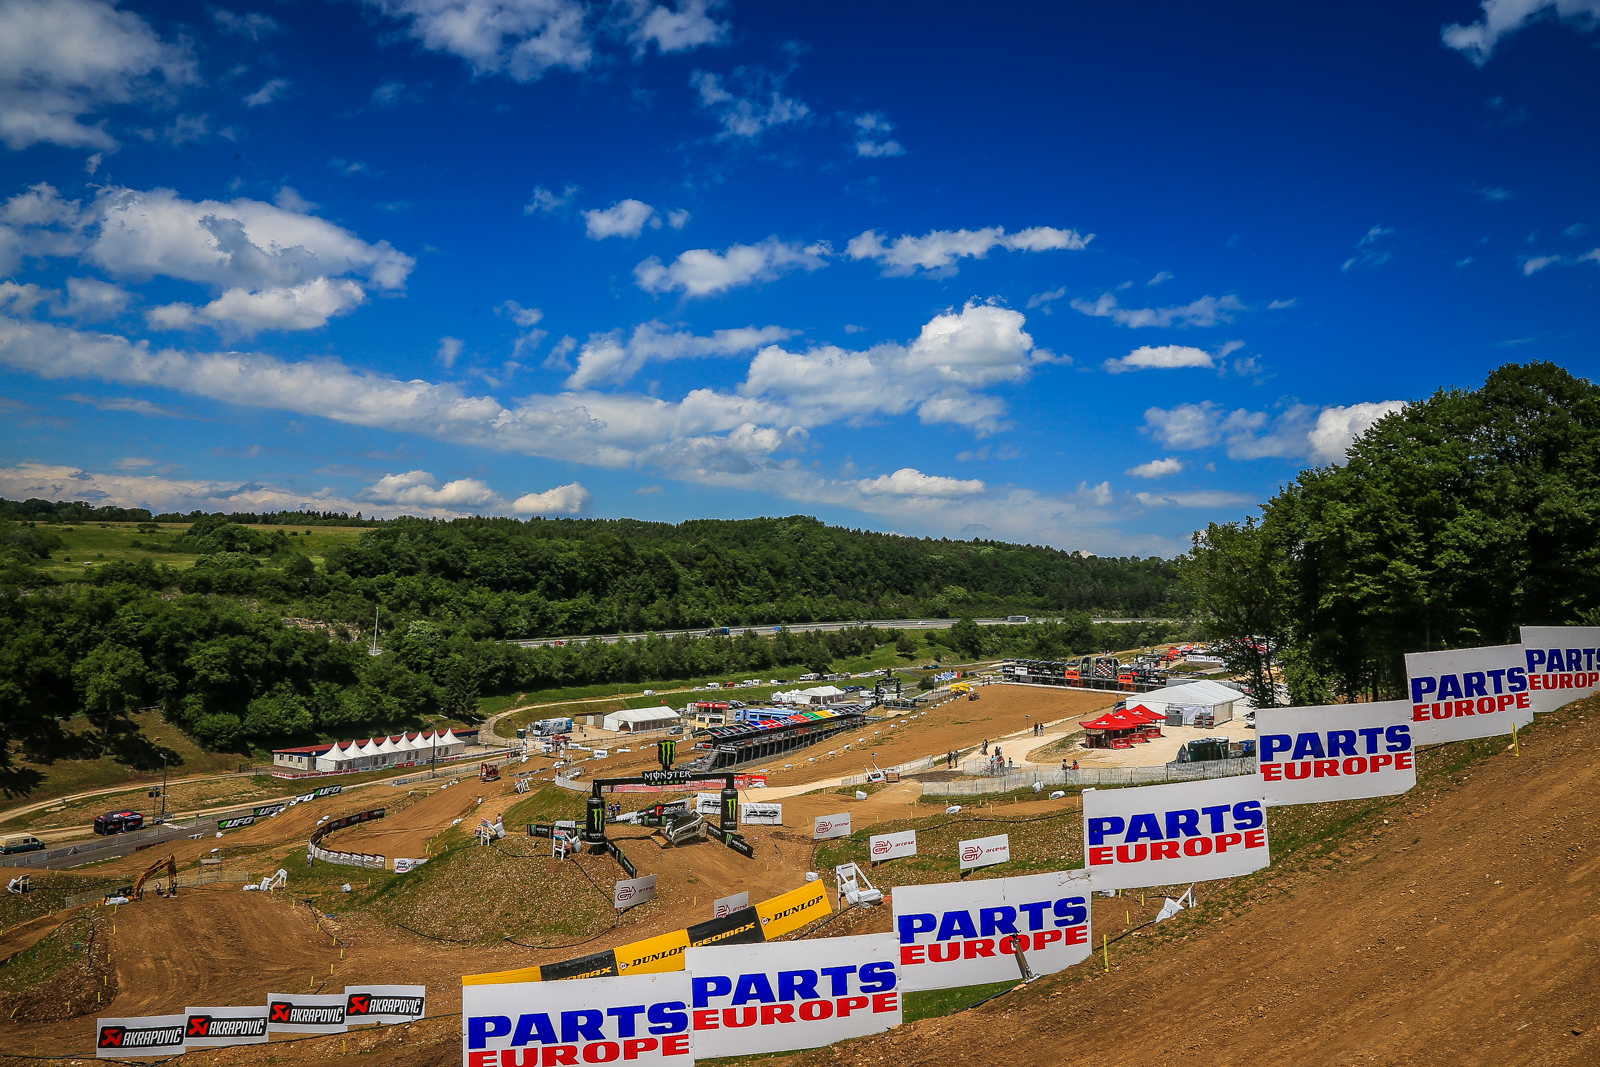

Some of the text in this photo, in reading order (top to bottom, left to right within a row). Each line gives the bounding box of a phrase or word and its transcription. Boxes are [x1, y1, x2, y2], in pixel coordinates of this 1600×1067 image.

[1525, 647, 1600, 673] PART
[1411, 667, 1528, 704] PARTS
[1528, 672, 1600, 691] EUROP
[1413, 692, 1531, 722] EUROPE
[1260, 724, 1412, 763] PARTS
[644, 770, 692, 781] MONSTER
[1260, 752, 1412, 782] EUROPE
[320, 785, 341, 796] UFO
[225, 816, 255, 828] UFO
[1089, 800, 1263, 846] PARTS
[895, 840, 915, 848] arcese
[985, 845, 1008, 853] arcese
[1090, 829, 1265, 866] EUROPE
[773, 895, 824, 921] DUNLOP
[898, 896, 1087, 944] PARTS
[692, 922, 756, 948] GEOMAX
[900, 925, 1088, 966] EUROPE
[631, 945, 687, 967] DUNLOP
[692, 961, 897, 1009] PARTS
[290, 1007, 344, 1023] AKRAPOVIČ
[369, 997, 421, 1014] AKRAPOVIČ
[693, 992, 898, 1031] EUROPE
[122, 1027, 182, 1046] AKRAPOVIČ
[209, 1018, 264, 1036] AKRAPOVIČ
[468, 1001, 689, 1050] PARTS
[468, 1034, 690, 1067] EUROPE
